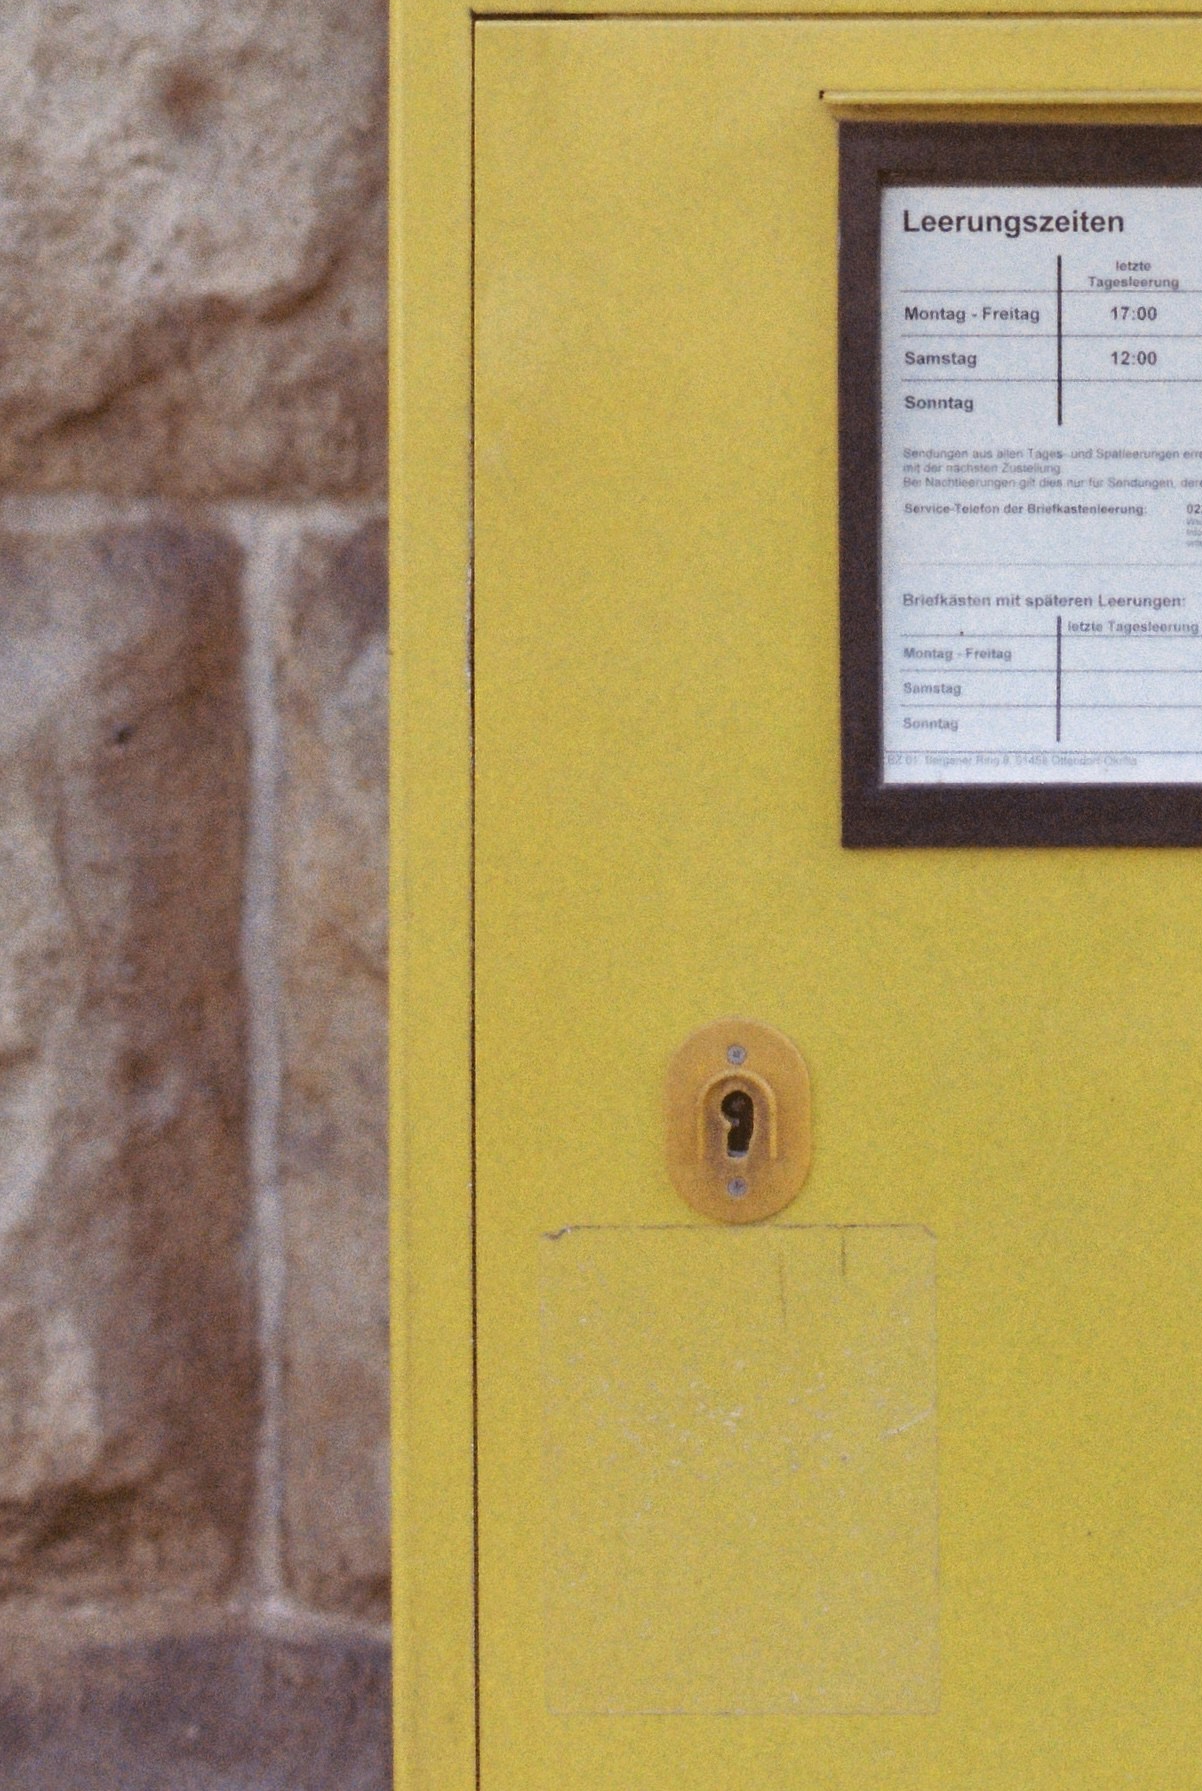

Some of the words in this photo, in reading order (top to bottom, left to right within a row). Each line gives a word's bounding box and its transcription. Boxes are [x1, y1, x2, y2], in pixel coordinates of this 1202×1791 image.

[903, 209, 1125, 237] Leerungszeiten
[1115, 260, 1151, 272] letzte
[1089, 276, 1179, 291] Tagesleerung
[905, 306, 966, 324] Montag
[983, 306, 1039, 323] Freitag
[1110, 306, 1157, 322] 17:00
[904, 351, 977, 368] Samstag
[1110, 351, 1157, 366] 12:00
[904, 395, 974, 412] Sonntag
[903, 448, 968, 460] Sendungen
[972, 450, 993, 458] aus
[997, 449, 1024, 458] allen
[1071, 448, 1093, 459] und
[903, 463, 920, 473] mit
[923, 463, 941, 473] der
[903, 477, 921, 487] Bei
[925, 477, 1016, 489] Nachtleerungen
[1019, 478, 1036, 489] gilt
[1039, 477, 1063, 488] dies
[1067, 479, 1084, 487] nur
[904, 503, 1000, 515] Service-Telefon
[1004, 503, 1023, 515] der
[1027, 503, 1148, 517] Briefkastenleerung:
[903, 594, 991, 607] Briefkästen
[996, 594, 1021, 607] mit
[1025, 594, 1093, 611] späteren
[1098, 594, 1186, 611] Leerungen:
[1068, 622, 1104, 634] letzte
[1108, 622, 1199, 636] Tagesleerung
[903, 647, 954, 662] Montag
[966, 647, 1011, 662] Freitag
[903, 682, 962, 697] Samstag
[903, 717, 958, 732] Sonntag
